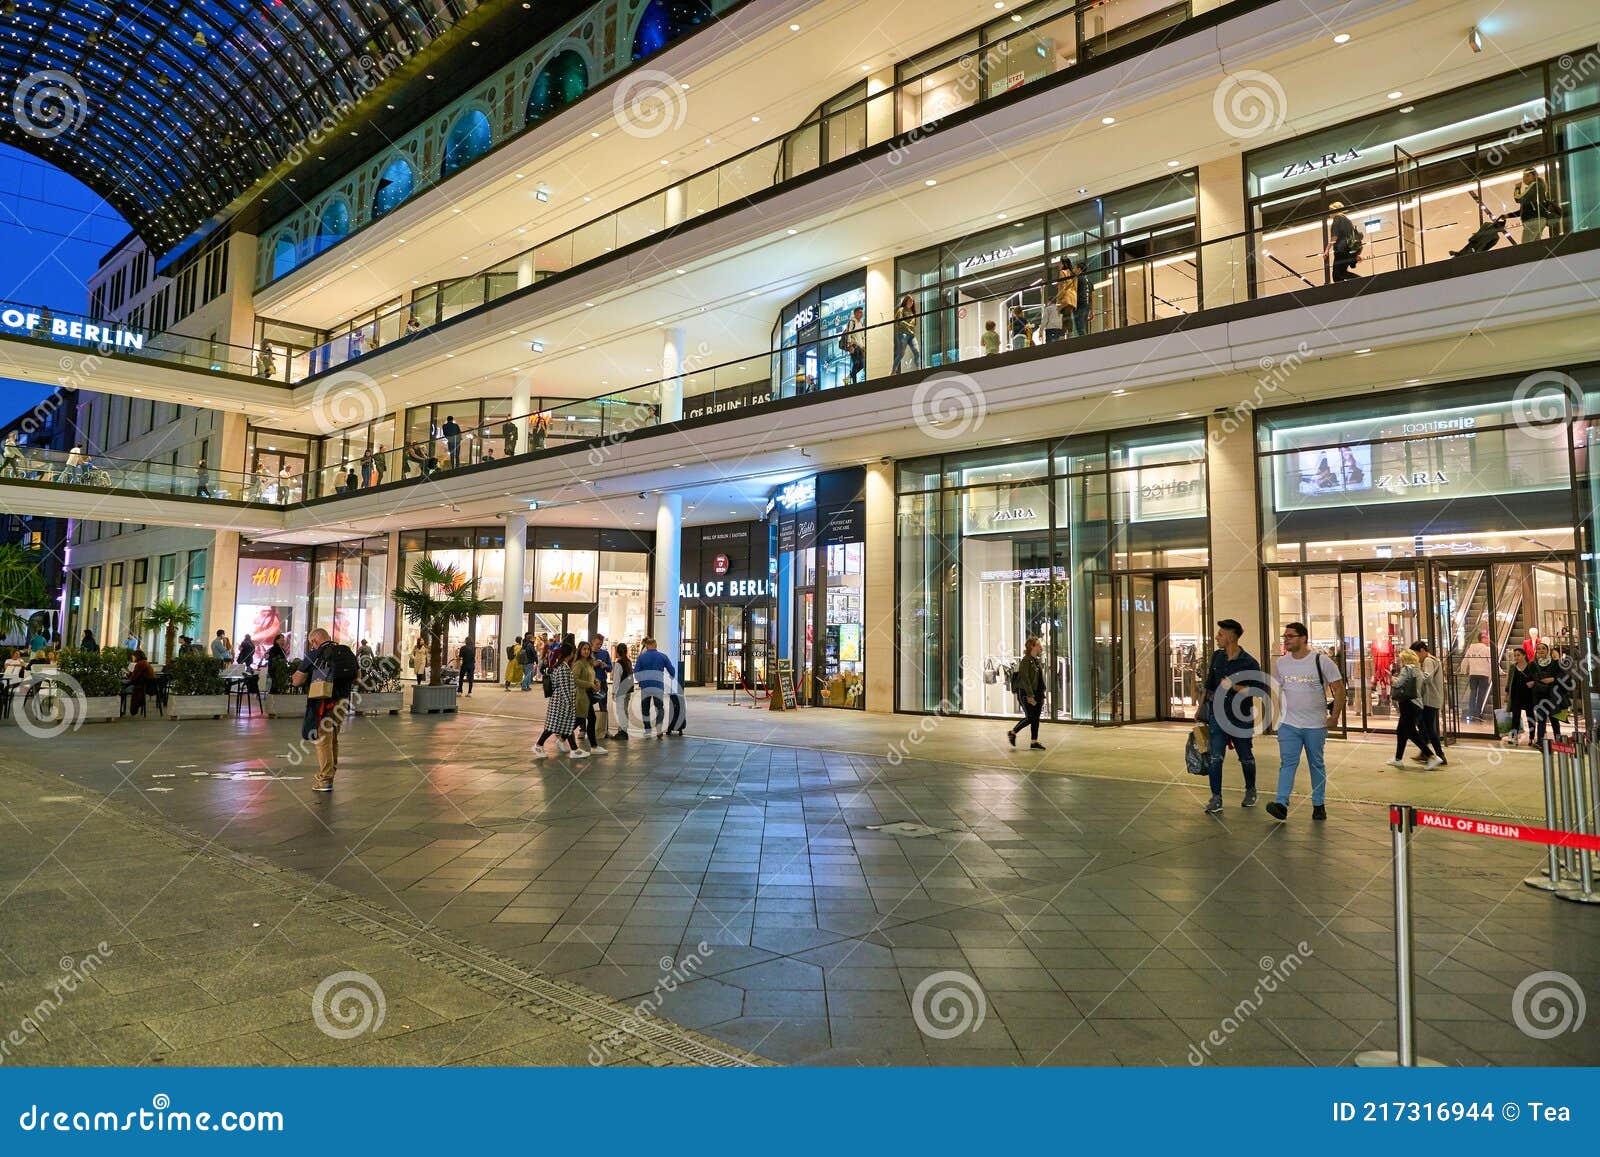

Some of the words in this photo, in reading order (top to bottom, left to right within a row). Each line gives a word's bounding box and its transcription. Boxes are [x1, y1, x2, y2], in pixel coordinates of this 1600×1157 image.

[1282, 147, 1361, 178] ZARA
[965, 245, 1016, 268] ZARA
[2, 309, 39, 330] OF
[51, 318, 143, 350] BERLIN
[1376, 469, 1449, 488] ZARA
[992, 507, 1036, 521] ZARA
[679, 582, 700, 598] ALL
[705, 581, 724, 598] OF
[730, 579, 768, 596] BERLI
[1423, 815, 1454, 829] MALL
[1457, 819, 1473, 831] OF
[1477, 823, 1519, 838] BERLIN
